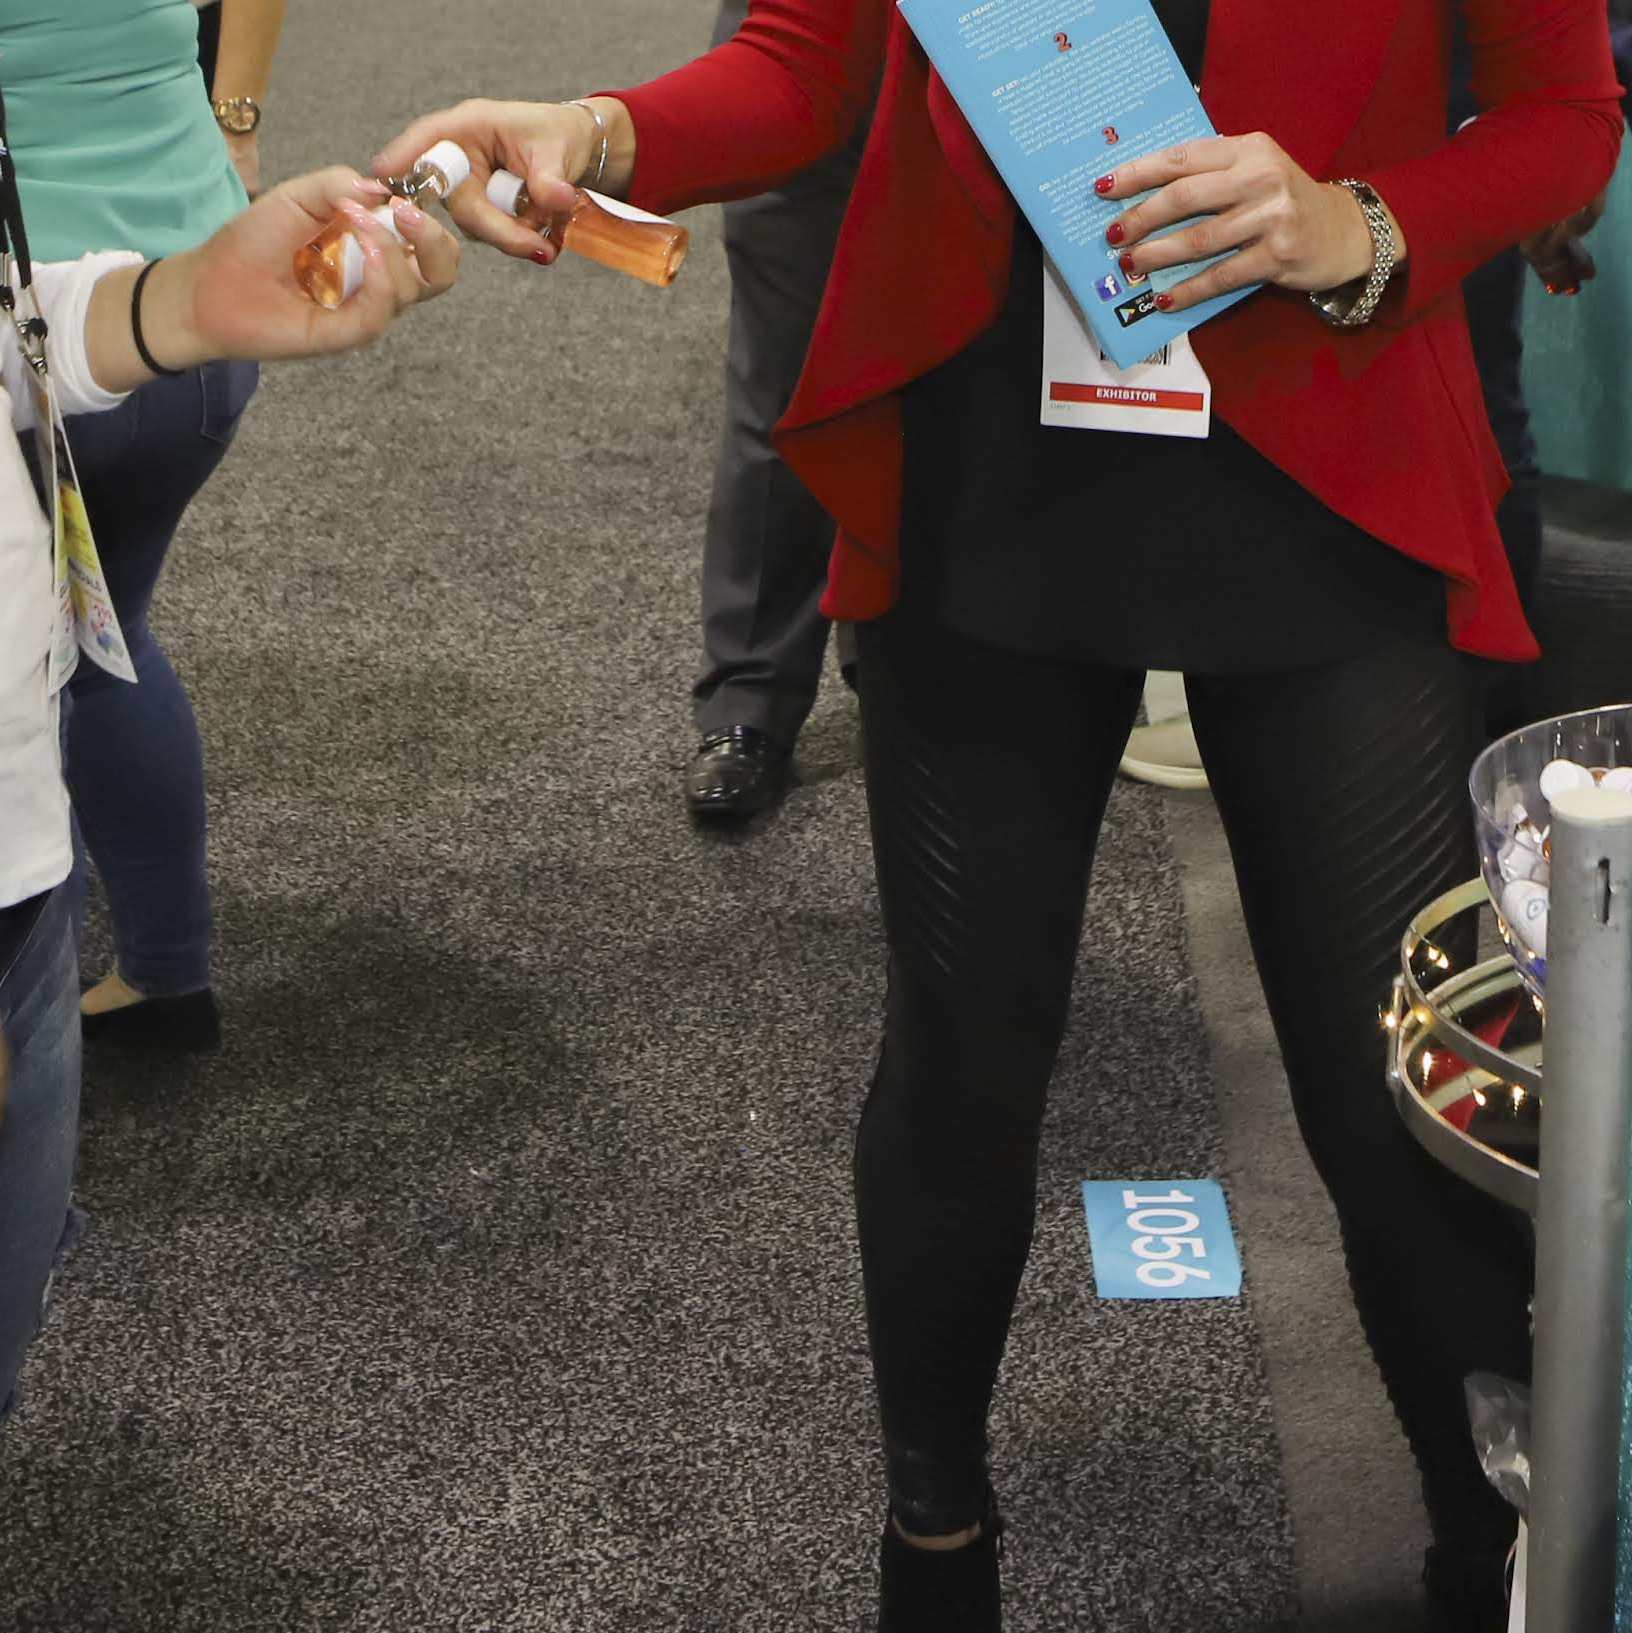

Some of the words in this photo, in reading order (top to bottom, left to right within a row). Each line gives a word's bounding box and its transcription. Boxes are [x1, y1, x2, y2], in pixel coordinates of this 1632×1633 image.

[1053, 32, 1072, 53] 2
[1103, 126, 1120, 146] 3
[1096, 387, 1158, 403] EXHIBITOR
[1122, 1189, 1212, 1288] 1056
